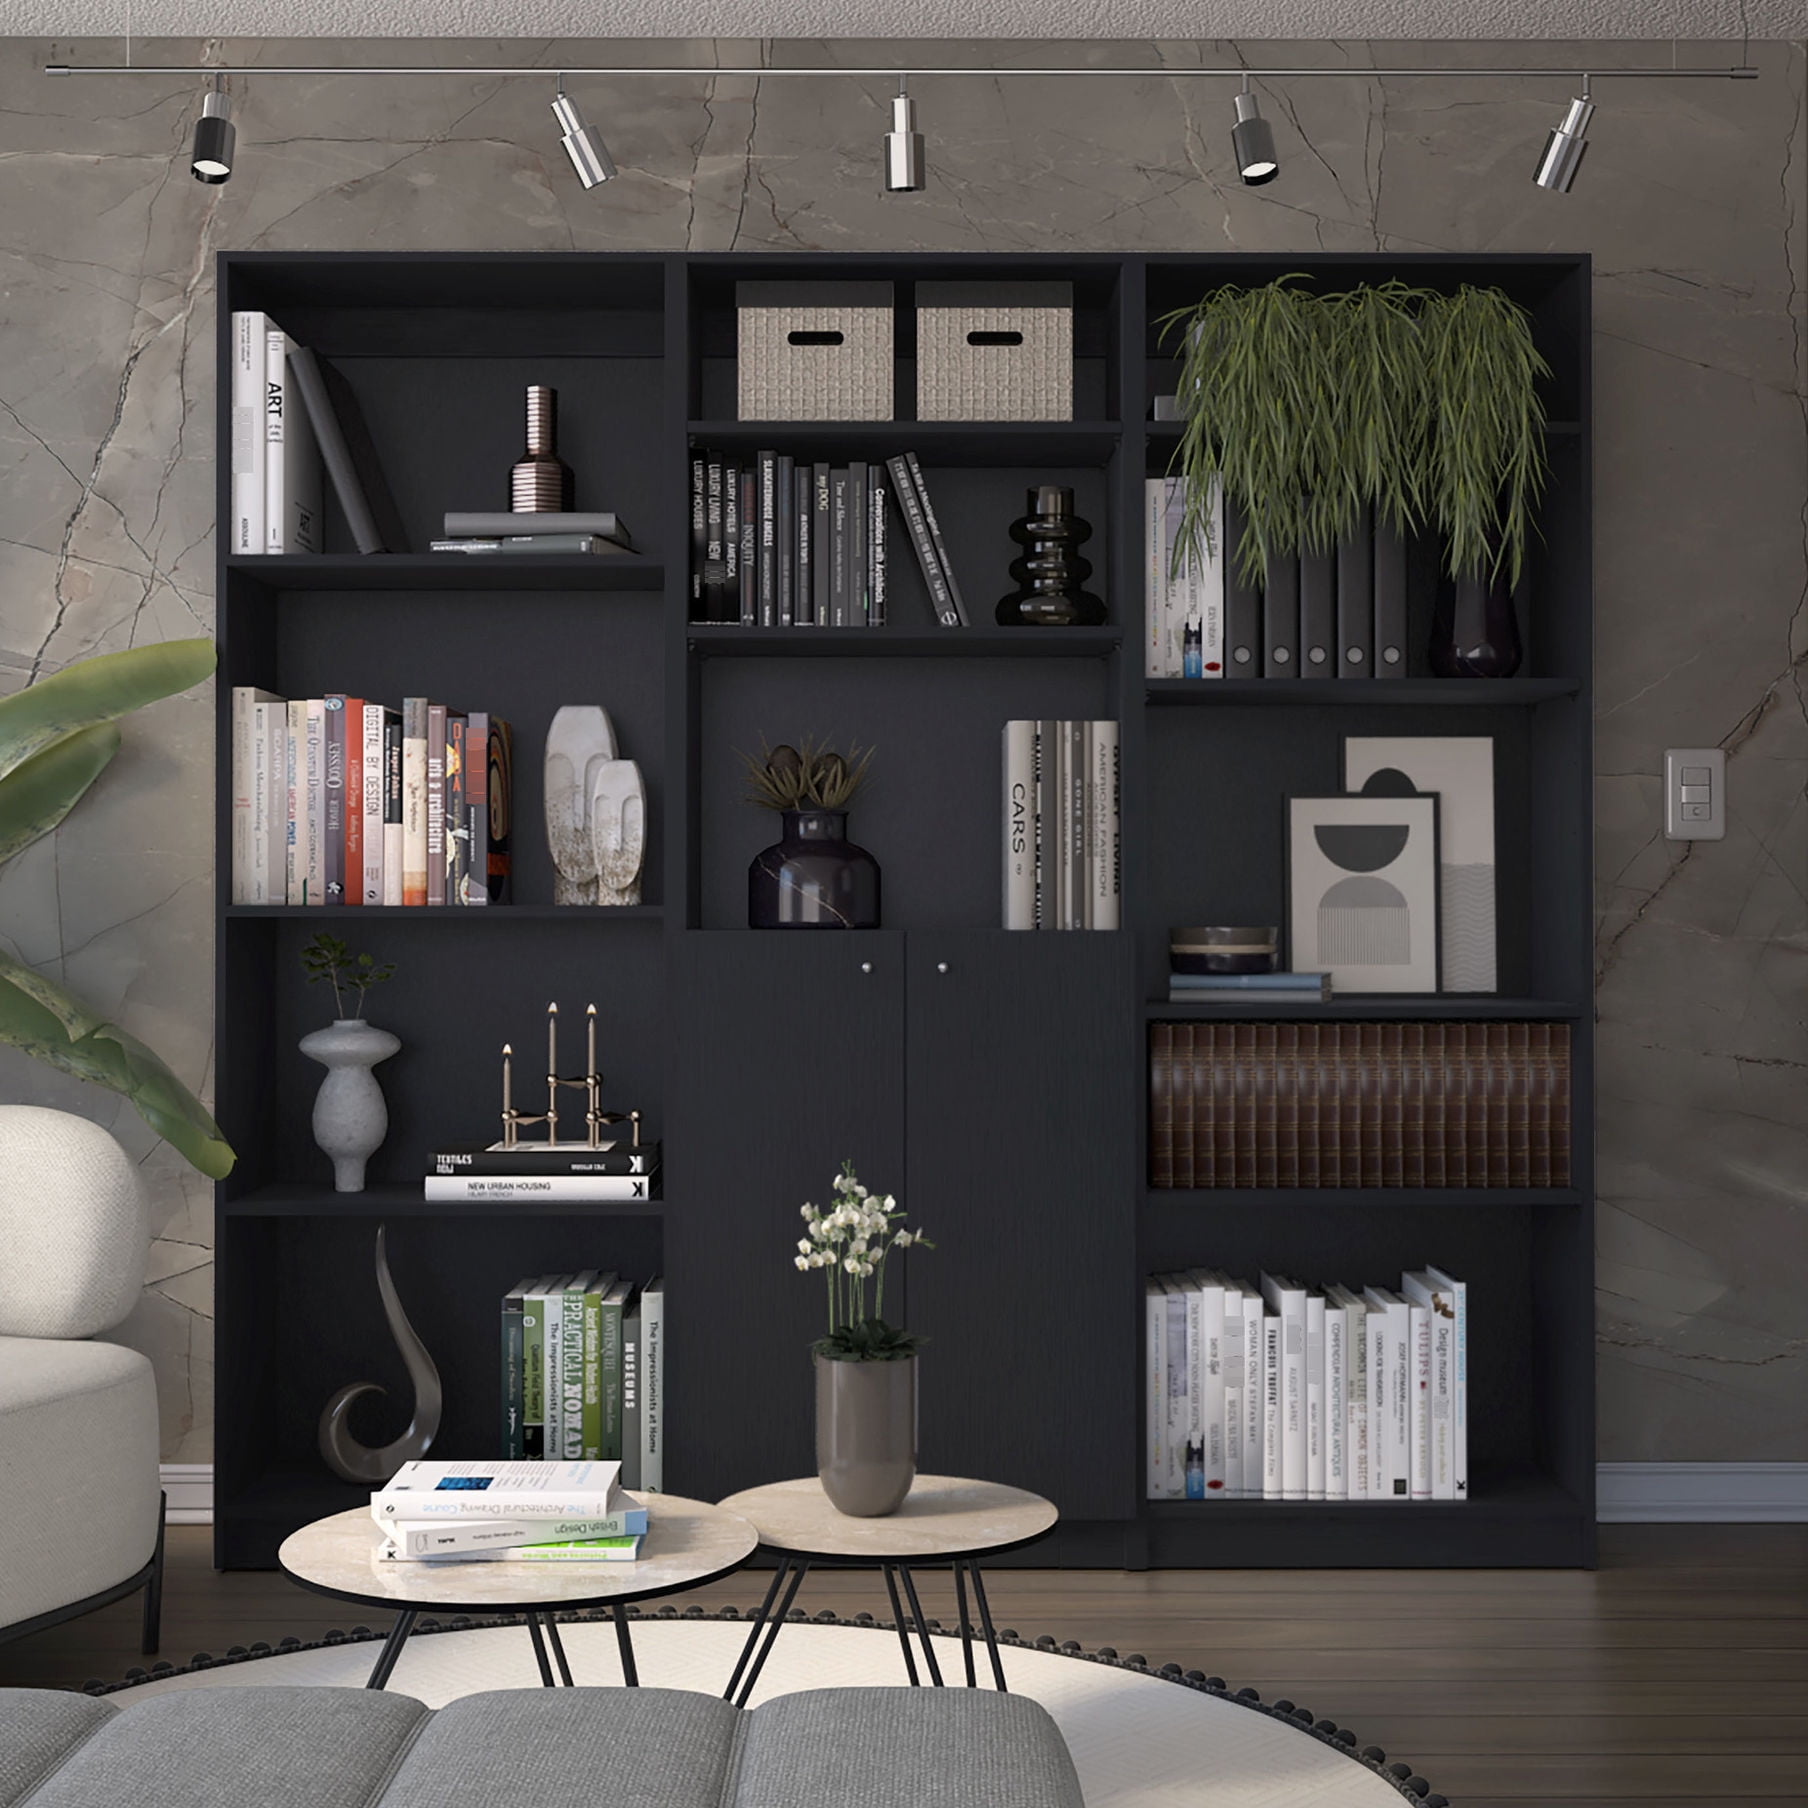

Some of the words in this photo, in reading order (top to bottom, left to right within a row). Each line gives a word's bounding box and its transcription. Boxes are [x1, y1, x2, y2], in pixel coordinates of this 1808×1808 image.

[268, 383, 282, 417] ART
[694, 460, 703, 494] LUXURY
[708, 464, 721, 497] LUXURY
[727, 469, 736, 500] LUXURY
[694, 495, 703, 530] HOUSES
[708, 498, 721, 524] LIVING
[819, 489, 829, 510] DOG
[920, 492, 941, 536] Mockingbird
[727, 502, 736, 533] HOTELS
[836, 510, 845, 531] Silence
[875, 488, 884, 544] Conversations
[708, 541, 721, 560] NEW
[727, 543, 736, 578] AMERICA
[741, 524, 754, 567] INIQUITY
[875, 545, 884, 562] with
[875, 563, 884, 603] Architects
[366, 707, 379, 750] DIGITAL
[272, 728, 283, 780] SCARPA
[366, 757, 379, 769] BY
[390, 746, 400, 773] Jasper
[428, 758, 443, 779] arts
[366, 776, 379, 816] DESIGN
[390, 775, 400, 800] Johns
[1099, 742, 1107, 824] AMERICAN
[288, 821, 296, 845] POWER
[428, 794, 443, 855] architecture
[1012, 783, 1025, 854] CARS
[1099, 829, 1107, 898] FASHION
[467, 1182, 485, 1191] NEW
[487, 1182, 513, 1191] URBAN
[515, 1182, 551, 1191] HOUSING
[550, 1323, 559, 1339] The
[586, 1307, 597, 1328] Ancient
[650, 1321, 659, 1338] The
[1357, 1312, 1366, 1327] THE
[1457, 1306, 1465, 1348] CENTURY
[564, 1302, 582, 1381] PRACTICAL
[586, 1329, 597, 1352] Wisdom
[600, 1312, 616, 1373] MONTESQUIEU
[1249, 1319, 1257, 1357] WOMAN
[1267, 1329, 1276, 1368] FRANCOIS
[1331, 1322, 1340, 1374] COMPENDIUM
[1357, 1332, 1366, 1373] UNCOMMON
[1418, 1320, 1429, 1376] TULIPS
[1435, 1327, 1448, 1357] Design
[586, 1352, 597, 1361] for
[1457, 1350, 1465, 1381] HOUSE
[547, 1342, 559, 1412] Impressionists
[625, 1342, 635, 1409] MUSEUMS
[647, 1341, 659, 1411] Impressionists
[1249, 1360, 1257, 1385] ONLY
[1288, 1366, 1298, 1398] AUGUST
[1357, 1378, 1366, 1398] LIFE
[1438, 1358, 1446, 1395] museum
[550, 1414, 558, 1424] at
[650, 1414, 658, 1424] at
[1249, 1388, 1257, 1422] STEFAN
[1267, 1408, 1275, 1421] The
[1288, 1399, 1298, 1432] SARNITZ
[1331, 1375, 1340, 1436] ARCHITECTURAL
[1357, 1403, 1366, 1414] OF
[564, 1383, 582, 1459] NOMAD
[1249, 1424, 1257, 1443] MAY
[1357, 1418, 1366, 1450] COMMON
[550, 1426, 559, 1453] Home
[650, 1426, 659, 1453] Home
[1267, 1423, 1275, 1456] Complete
[1267, 1458, 1275, 1477] Films
[1331, 1438, 1340, 1477] ANTIQUES
[1357, 1454, 1366, 1491] OBJECTS
[421, 1503, 457, 1514] Course
[459, 1501, 499, 1514] Drawing
[503, 1503, 564, 1514] Architectural
[566, 1503, 585, 1514] The
[554, 1522, 586, 1535] Design
[587, 1519, 618, 1531] British
[551, 1551, 567, 1559] and
